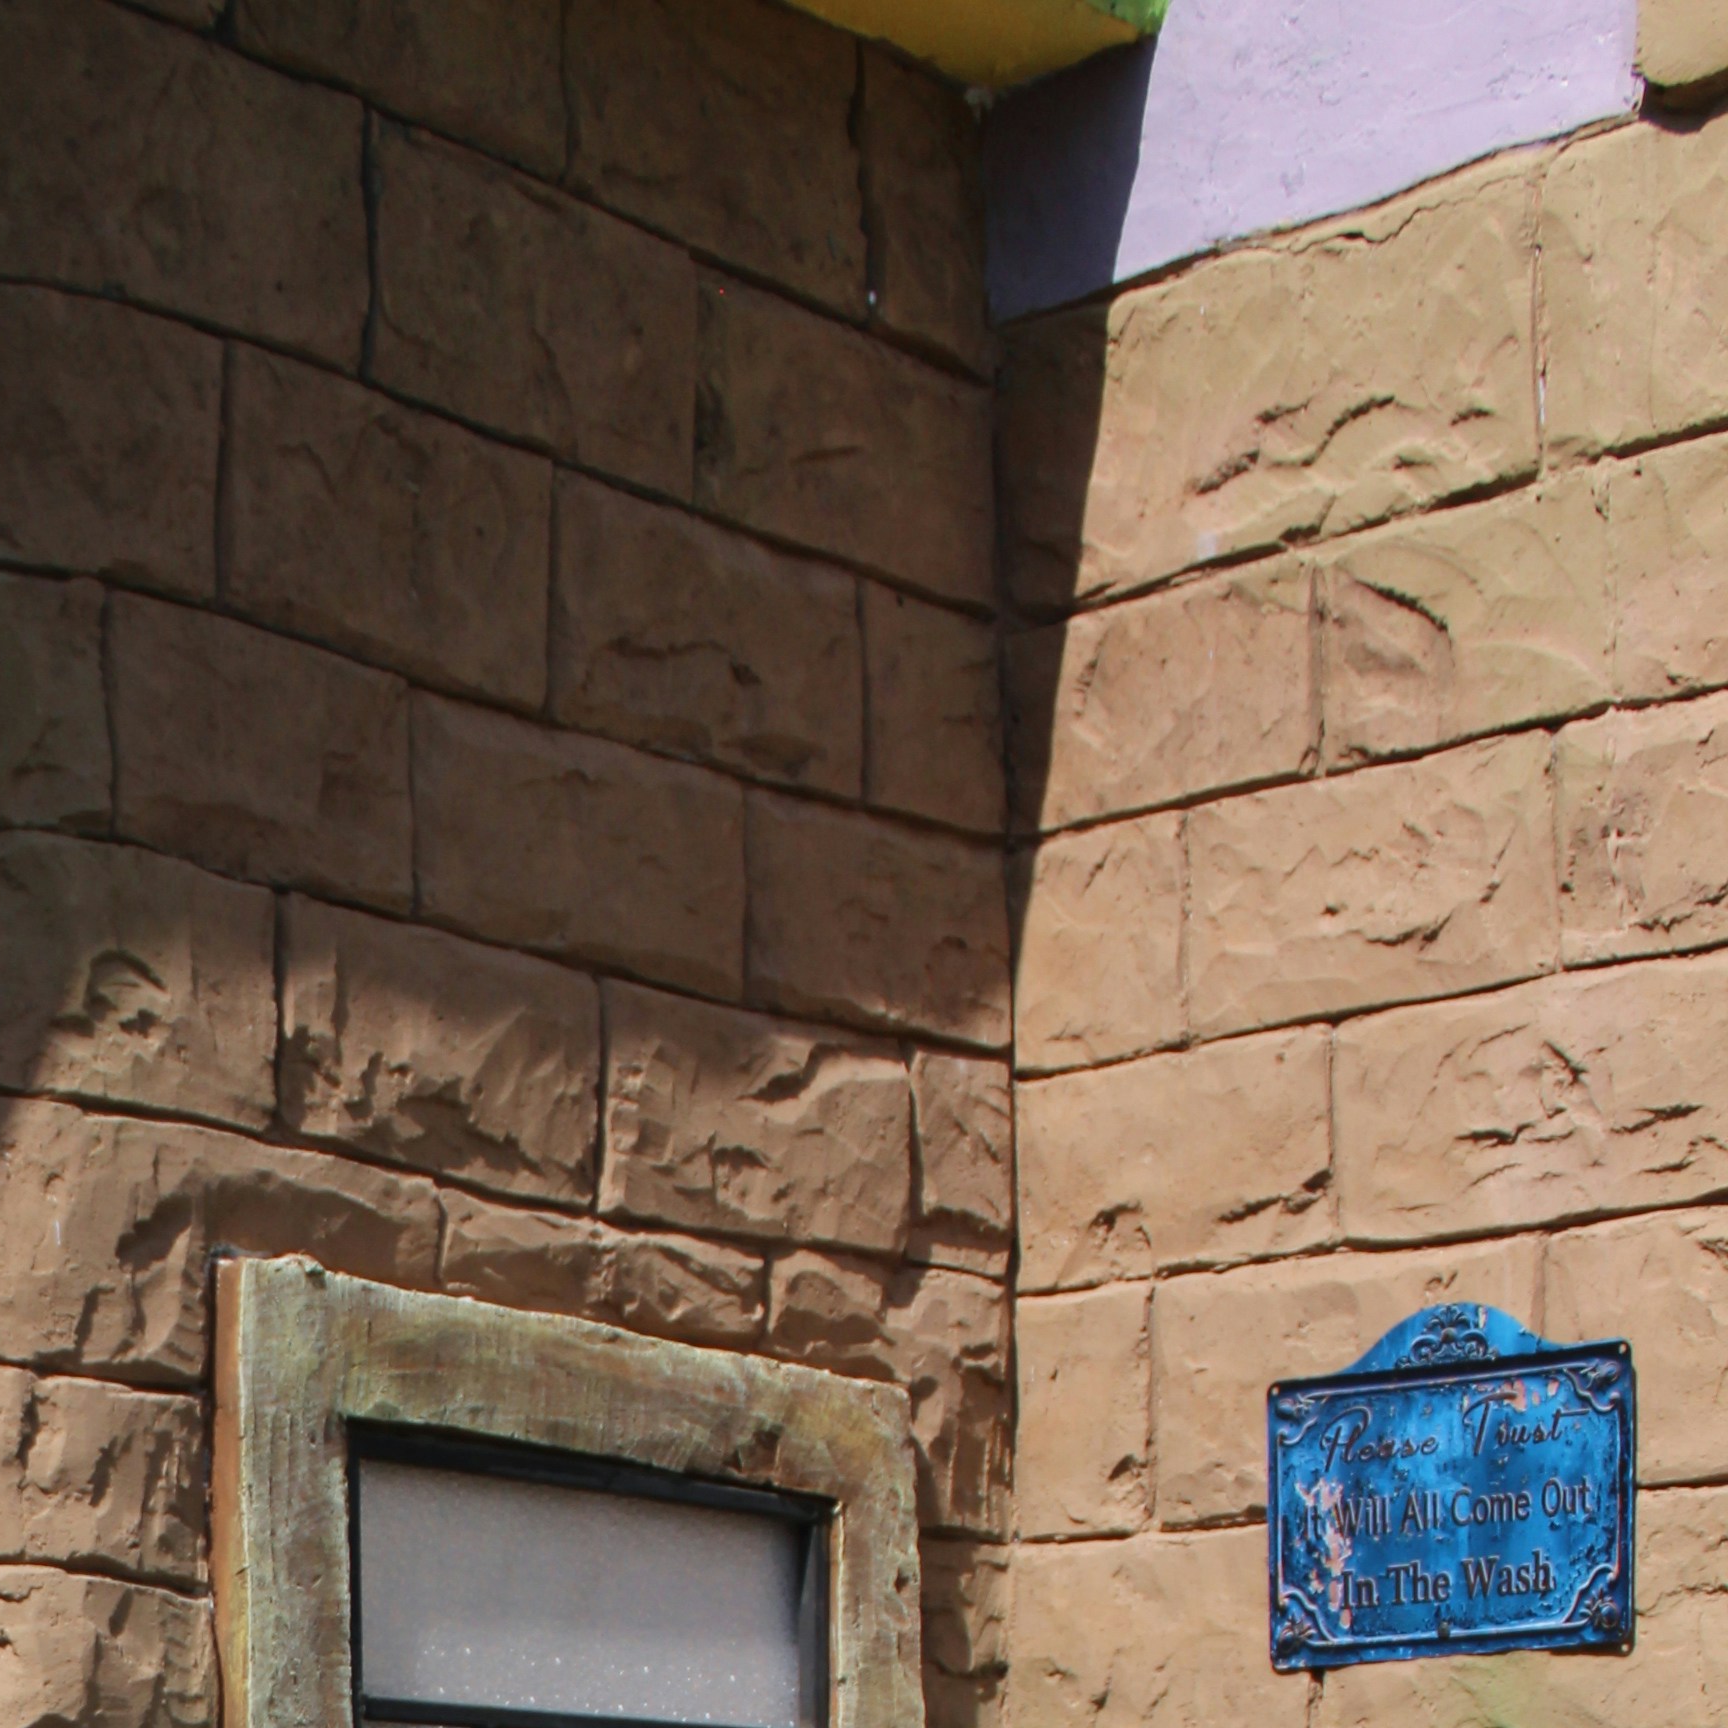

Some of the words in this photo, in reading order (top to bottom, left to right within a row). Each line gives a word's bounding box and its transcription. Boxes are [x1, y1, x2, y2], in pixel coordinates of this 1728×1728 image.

[1319, 1406, 1440, 1472] Please
[1462, 1391, 1590, 1457] Trust
[1336, 1494, 1391, 1539] Will
[1400, 1488, 1441, 1533] All
[1451, 1486, 1531, 1528] Come
[1541, 1476, 1592, 1518] Out
[1341, 1570, 1379, 1611] In
[1386, 1561, 1451, 1603] The
[1462, 1548, 1556, 1597] Wash
